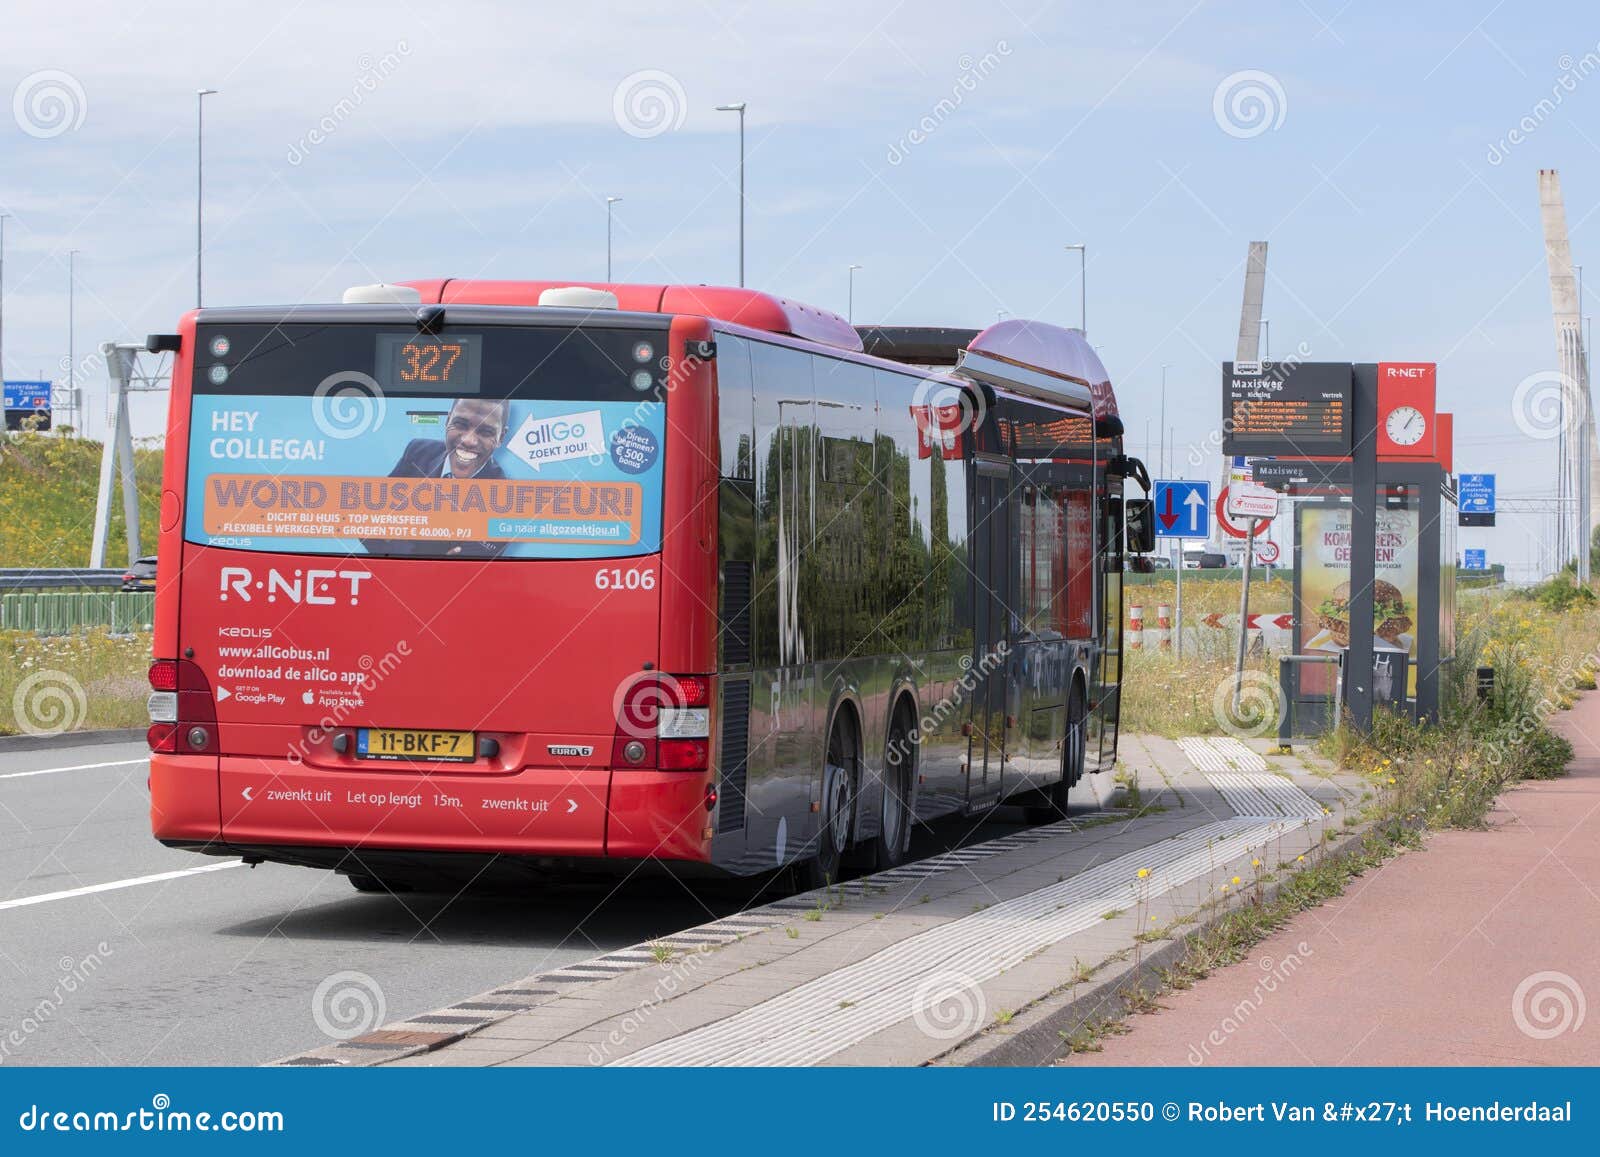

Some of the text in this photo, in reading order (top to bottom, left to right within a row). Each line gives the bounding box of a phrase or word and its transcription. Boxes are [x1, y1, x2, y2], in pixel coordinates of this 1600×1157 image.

[400, 344, 461, 381] 327
[1232, 379, 1283, 391] Maxisweg
[212, 410, 259, 432] HEY
[525, 422, 586, 446] allGo
[626, 432, 650, 445] Direct
[210, 438, 325, 460] COLLEGA!
[528, 442, 588, 460] ZOEKT JOU!
[616, 446, 624, 456] €
[618, 456, 640, 468] bonus
[1260, 466, 1304, 476] Maxisweg
[212, 479, 632, 517] WORD BUSCHAUFFEUR!
[267, 512, 428, 525] DICHT BIJ HUIS TOP WERKSFEER
[224, 523, 272, 533] FLEXIBELE
[275, 524, 335, 535] WERKGEVER
[343, 525, 386, 536] GROEIEN
[388, 526, 408, 537] TOT
[410, 528, 418, 536] €
[456, 528, 472, 538] P/J
[499, 523, 620, 538] Ga naar allgozoektjou.nl
[595, 568, 656, 590] 6106
[218, 645, 330, 661] www.allGobus.nl
[218, 664, 366, 685] download de allGo app
[235, 692, 286, 704] Google Play
[318, 696, 364, 707] App Store
[380, 732, 460, 752] 11-BKF-7
[551, 746, 590, 756] EURO 6
[267, 788, 548, 812] zwenkt uit Let op lengt 15m. zwenkt uit
